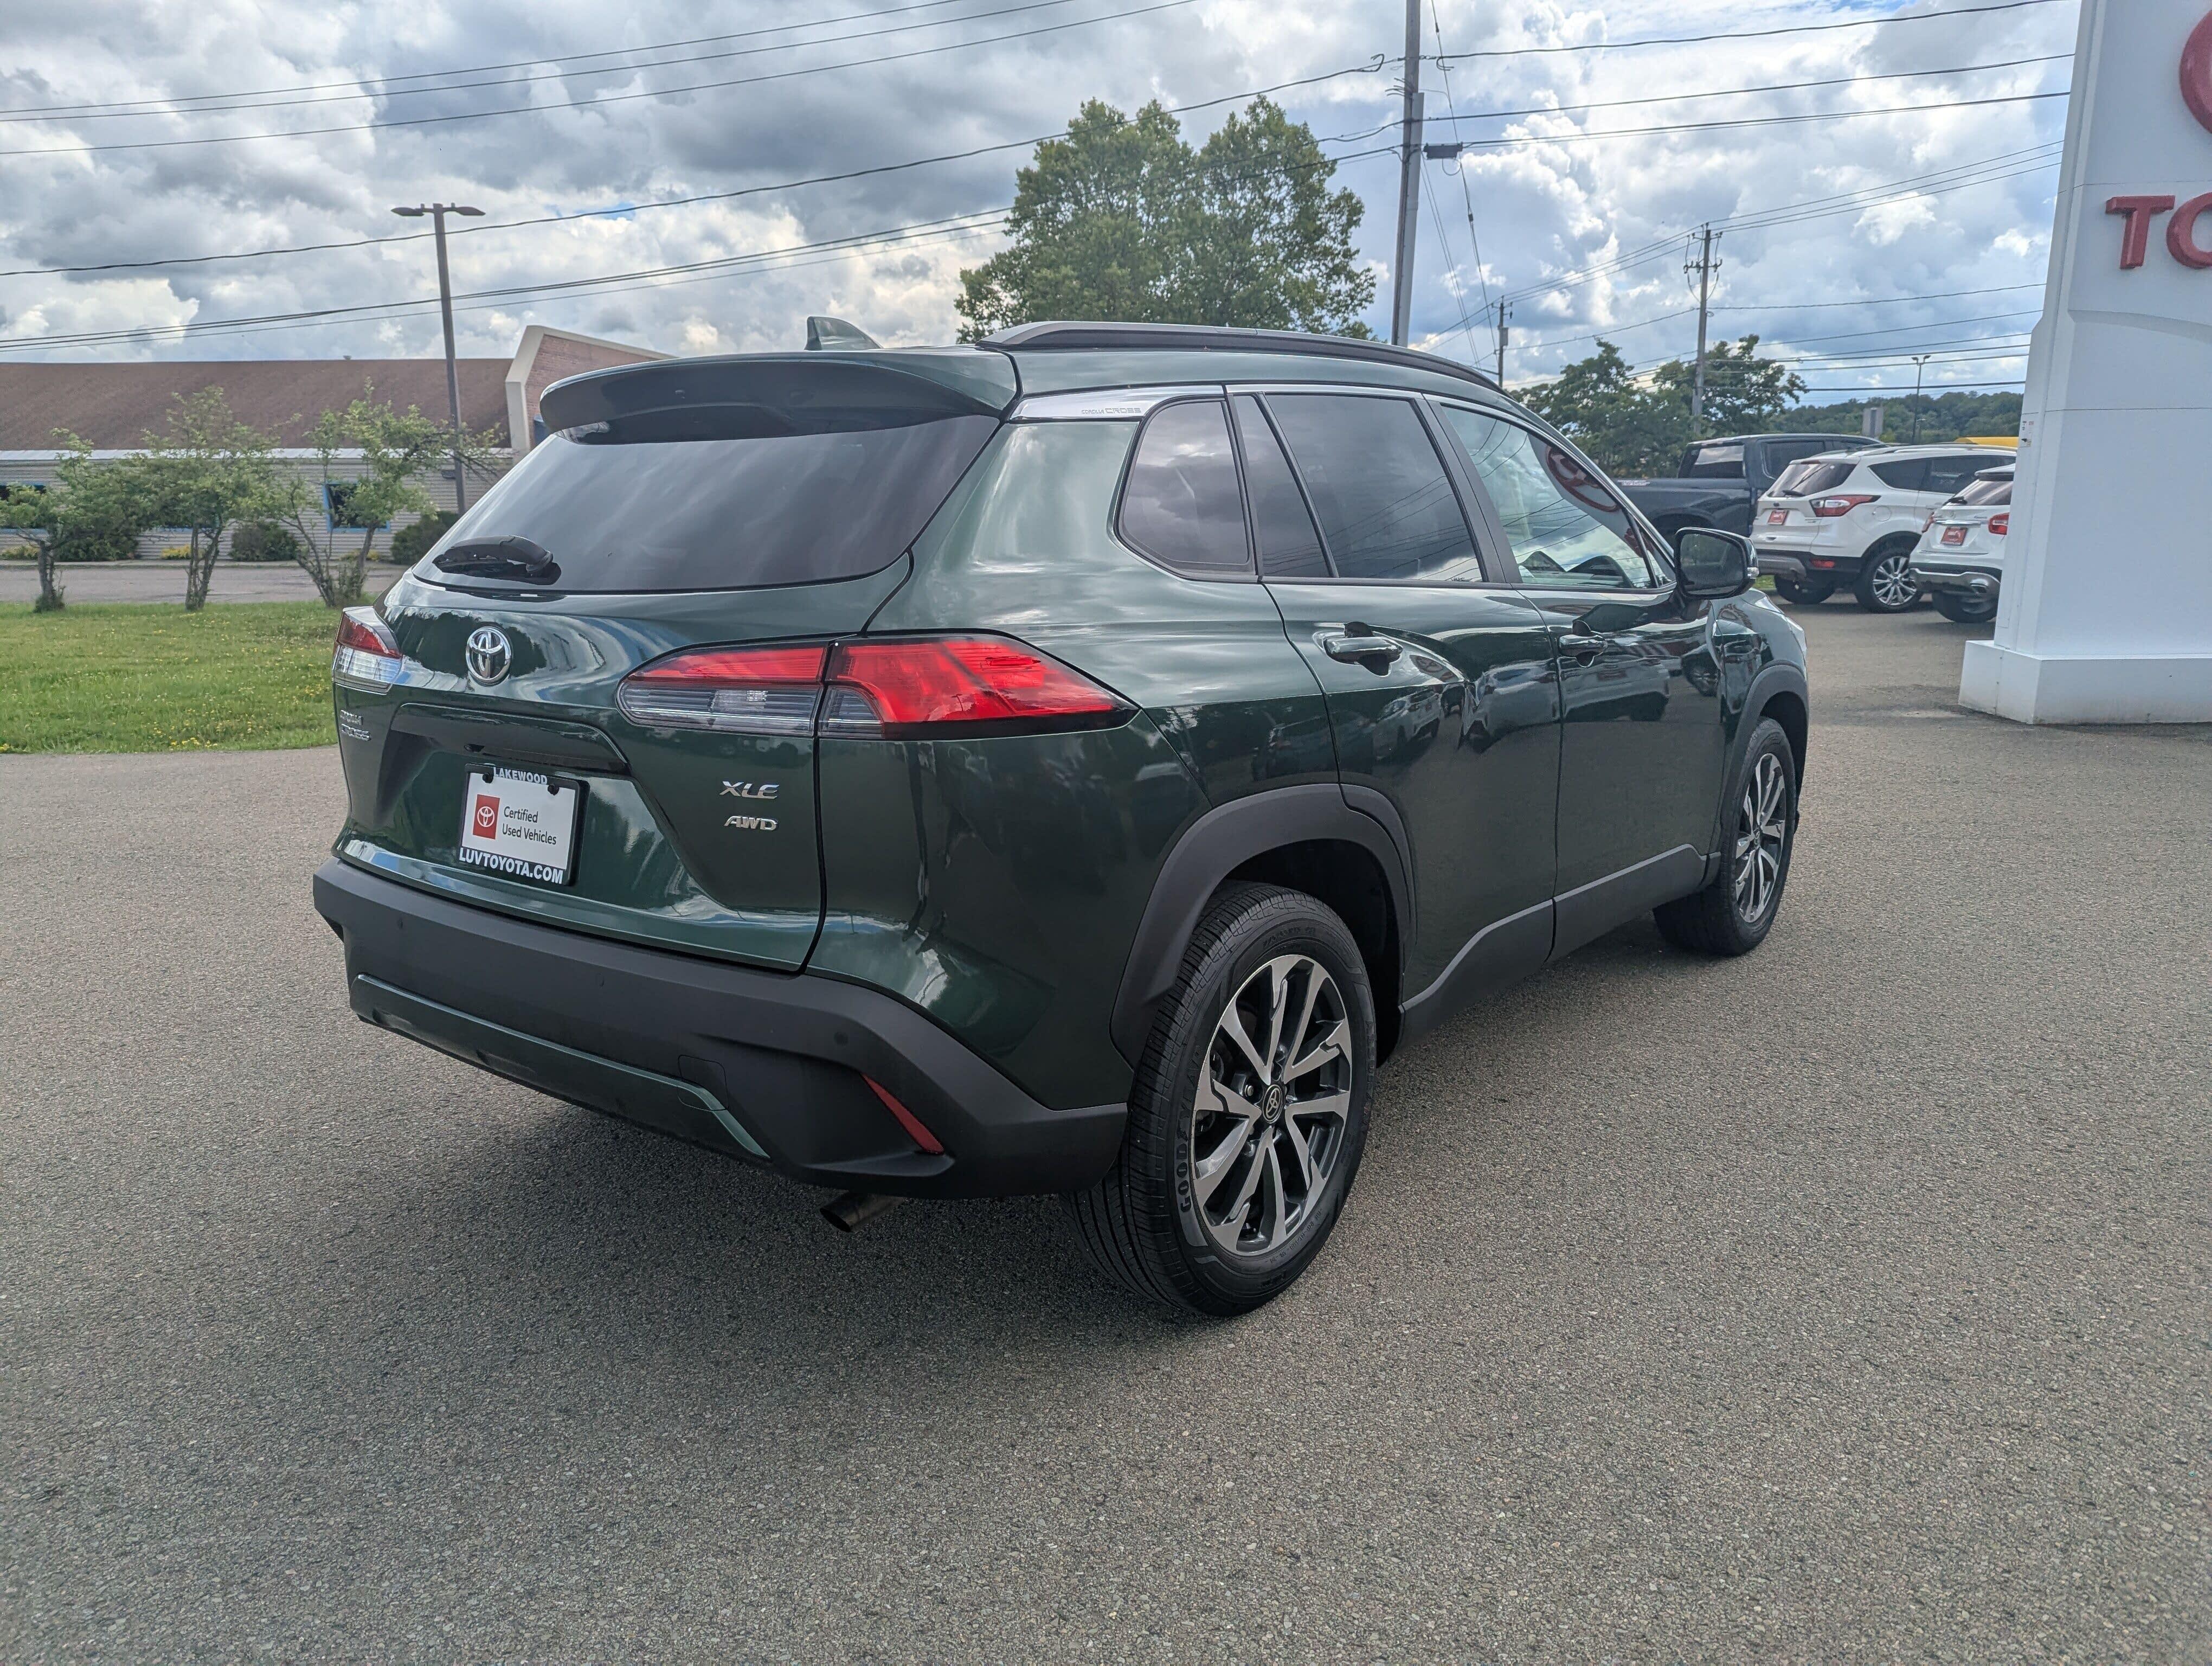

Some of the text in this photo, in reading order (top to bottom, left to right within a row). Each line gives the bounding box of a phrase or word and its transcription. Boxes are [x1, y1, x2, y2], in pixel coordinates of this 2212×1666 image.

[493, 767, 548, 785] LAKEWOOD
[719, 781, 780, 799] XLE
[504, 806, 538, 823] Certified
[724, 815, 779, 831] AWD
[502, 823, 557, 845] Used Vehicles
[459, 847, 563, 885] LUVTOYOTA.COM
